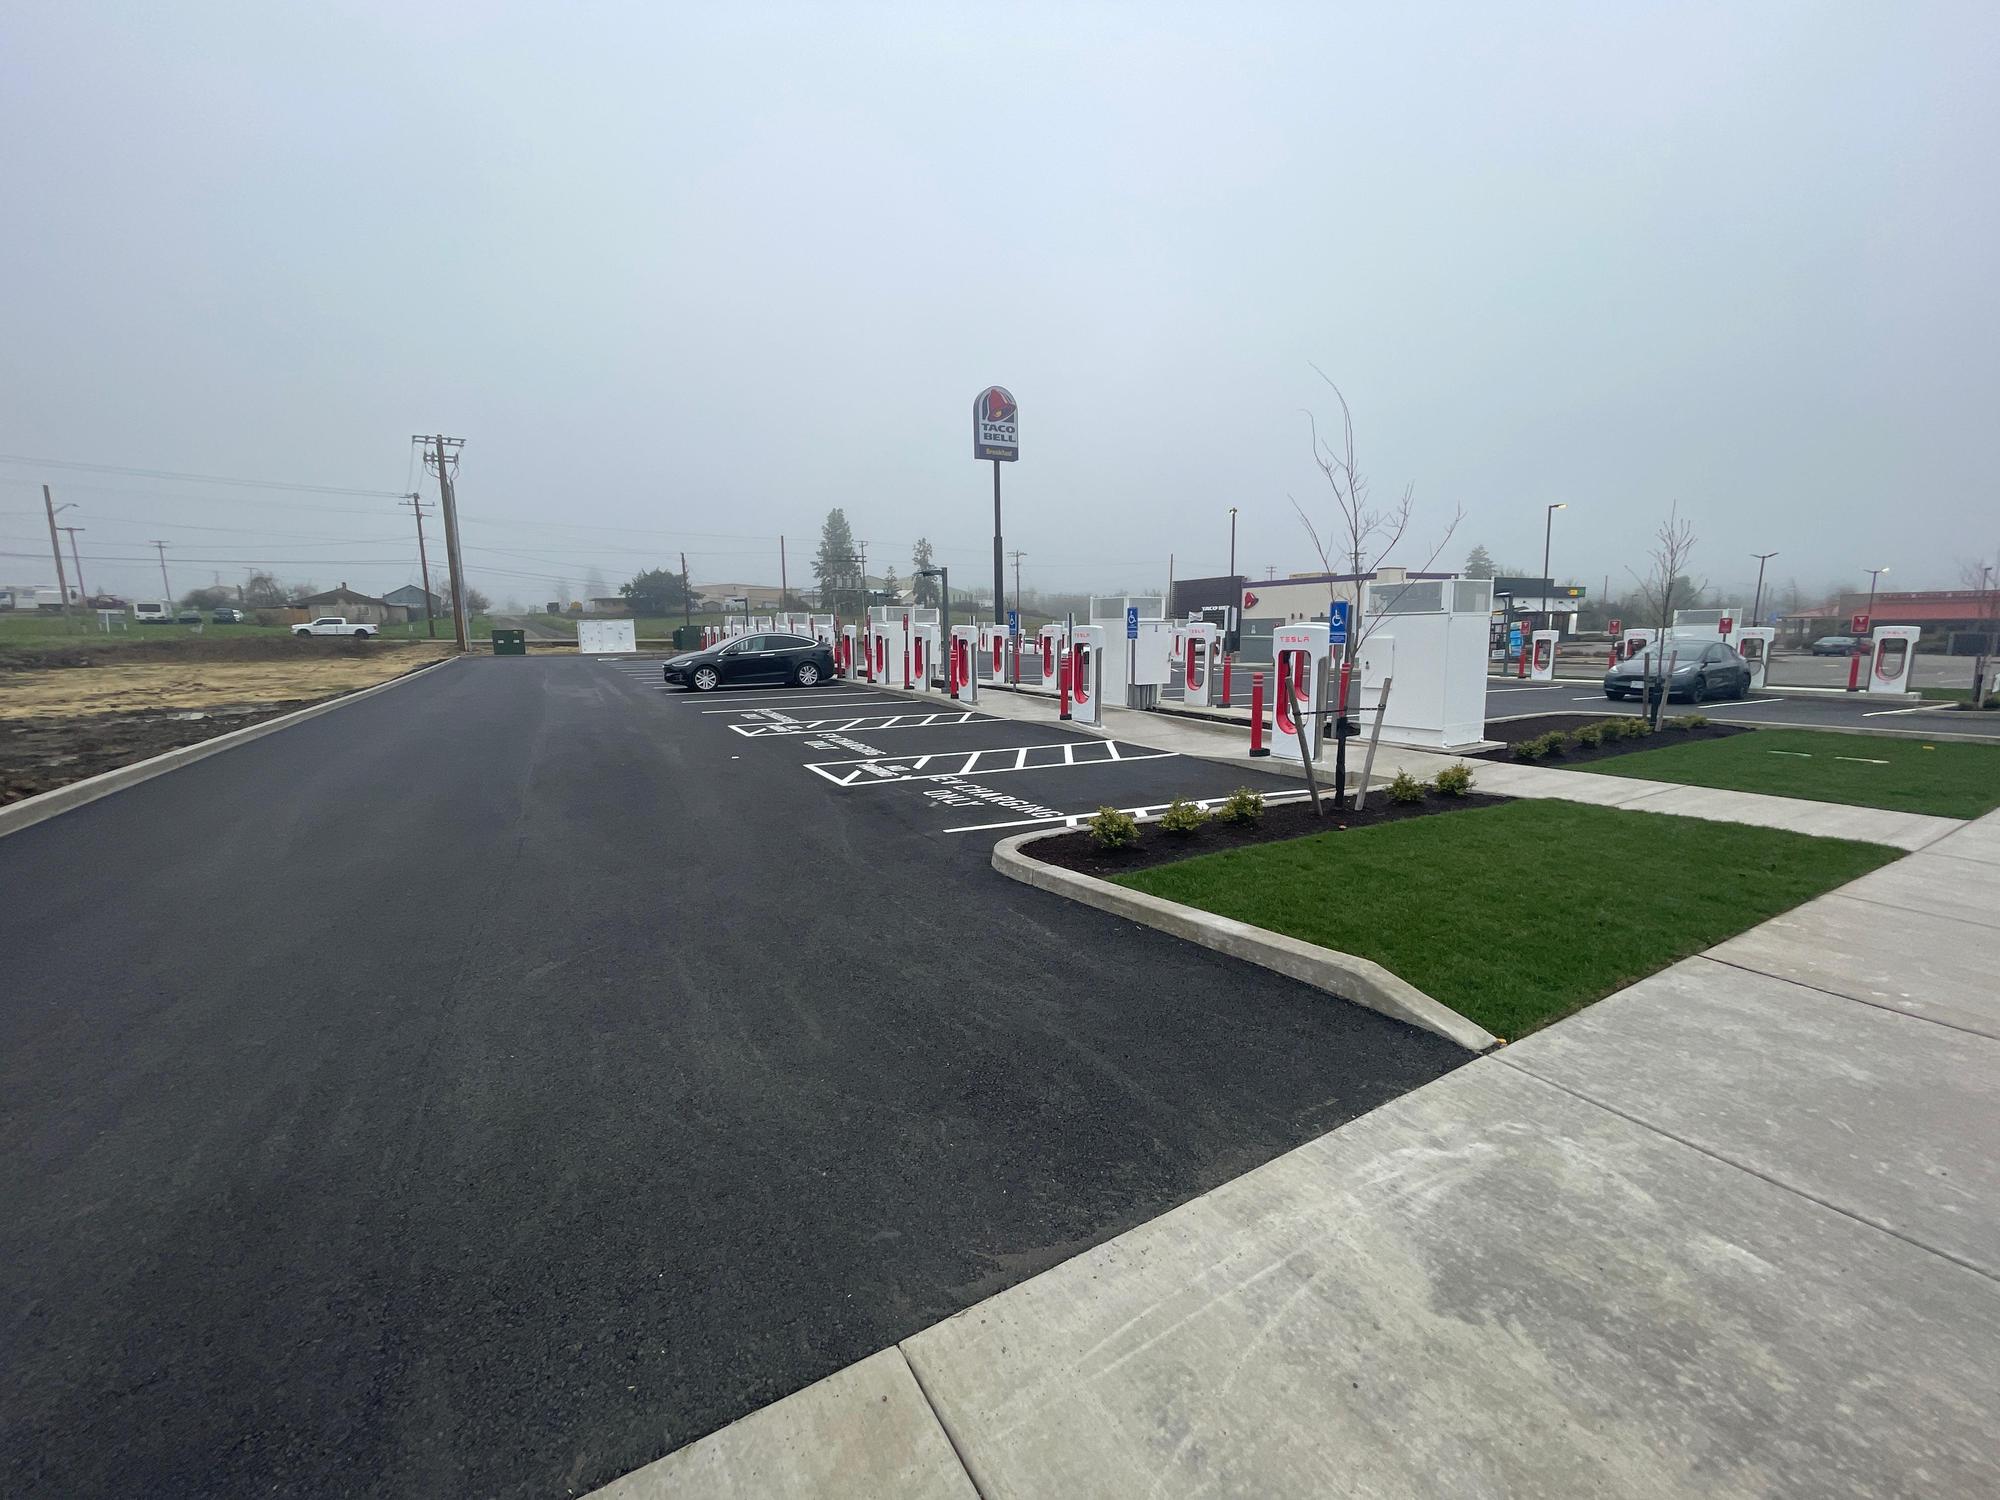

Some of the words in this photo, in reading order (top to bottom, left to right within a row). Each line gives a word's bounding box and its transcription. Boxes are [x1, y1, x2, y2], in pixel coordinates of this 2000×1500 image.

[981, 423, 1015, 434] TACO
[983, 432, 1016, 442] BELL
[923, 789, 985, 807] ONLY
[929, 775, 967, 785] EV
[953, 783, 1065, 818] CHARGING
